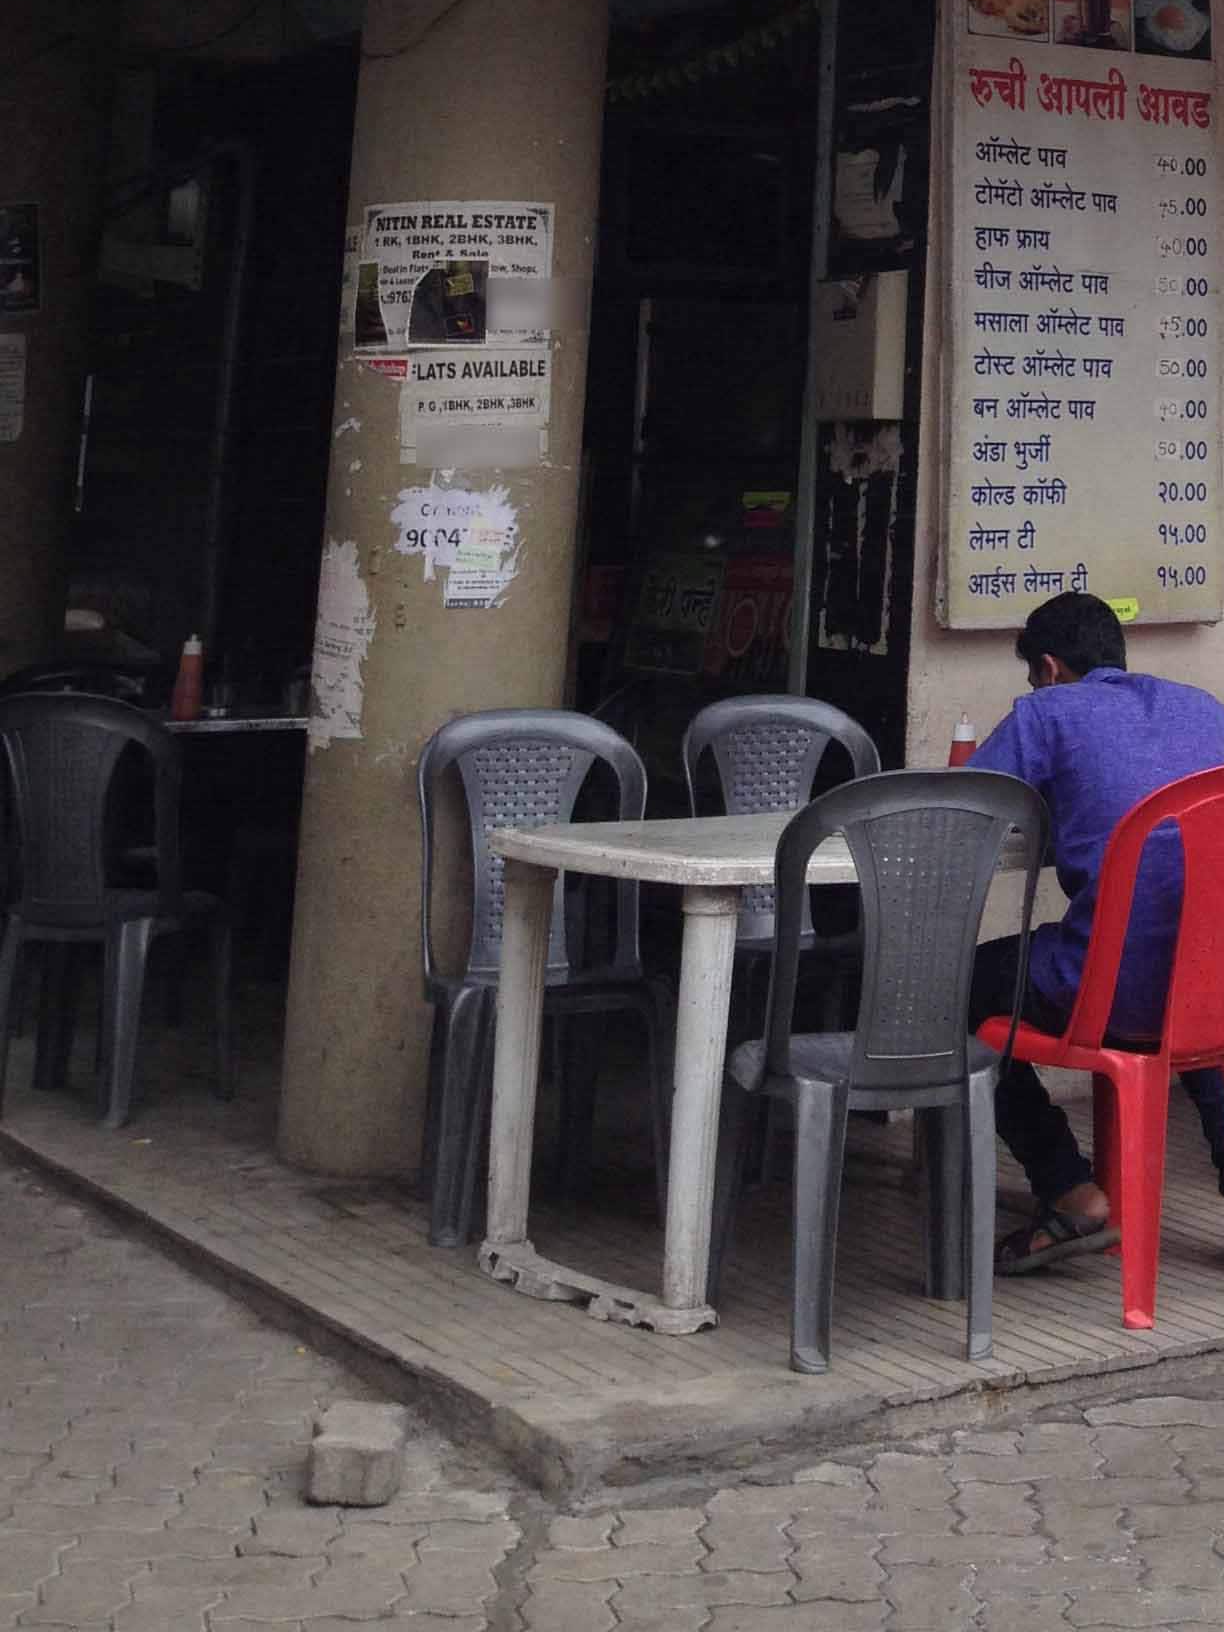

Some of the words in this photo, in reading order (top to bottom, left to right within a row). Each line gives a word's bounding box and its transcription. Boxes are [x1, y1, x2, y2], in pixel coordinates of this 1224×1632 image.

[969, 57, 1027, 111] रुची
[1037, 68, 1128, 120] आपली
[1136, 84, 1211, 129] आवड
[975, 136, 1032, 166] ऑम्लेट
[1038, 147, 1068, 168] पाव
[974, 177, 1024, 207] टोमॅटो
[1030, 182, 1086, 210] ऑम्लेट
[1092, 193, 1118, 213] पाव
[376, 215, 417, 231] NITIN
[422, 215, 467, 228] REAL
[472, 215, 536, 229] ESTATE
[449, 234, 492, 245] 2BHK,
[974, 226, 1010, 250] हाफ
[1016, 229, 1050, 250] फ्राय
[975, 262, 1012, 290] चीज
[1019, 265, 1074, 292] ऑम्लेट
[1082, 274, 1109, 294] पाव
[974, 312, 1029, 333] मसाला
[1036, 307, 1091, 335] ऑम्लेट
[1099, 317, 1125, 336] पाव
[412, 362, 456, 380] LATS
[461, 360, 546, 379] AVAILABLE
[974, 347, 1015, 375] टोस्ट
[1023, 349, 1076, 376] ऑम्लेट
[1082, 358, 1113, 378] पाव
[973, 399, 999, 418] बन
[1006, 392, 1061, 419] ऑम्लेट
[1068, 400, 1096, 419] पाव
[972, 435, 1007, 462] अंडा
[971, 477, 1016, 506] कोल्ड
[1023, 477, 1067, 504] कॉफी
[969, 521, 1010, 550] लेमन
[1017, 520, 1036, 549] टी
[969, 566, 1016, 598] आईस
[1024, 564, 1064, 592] लेमन
